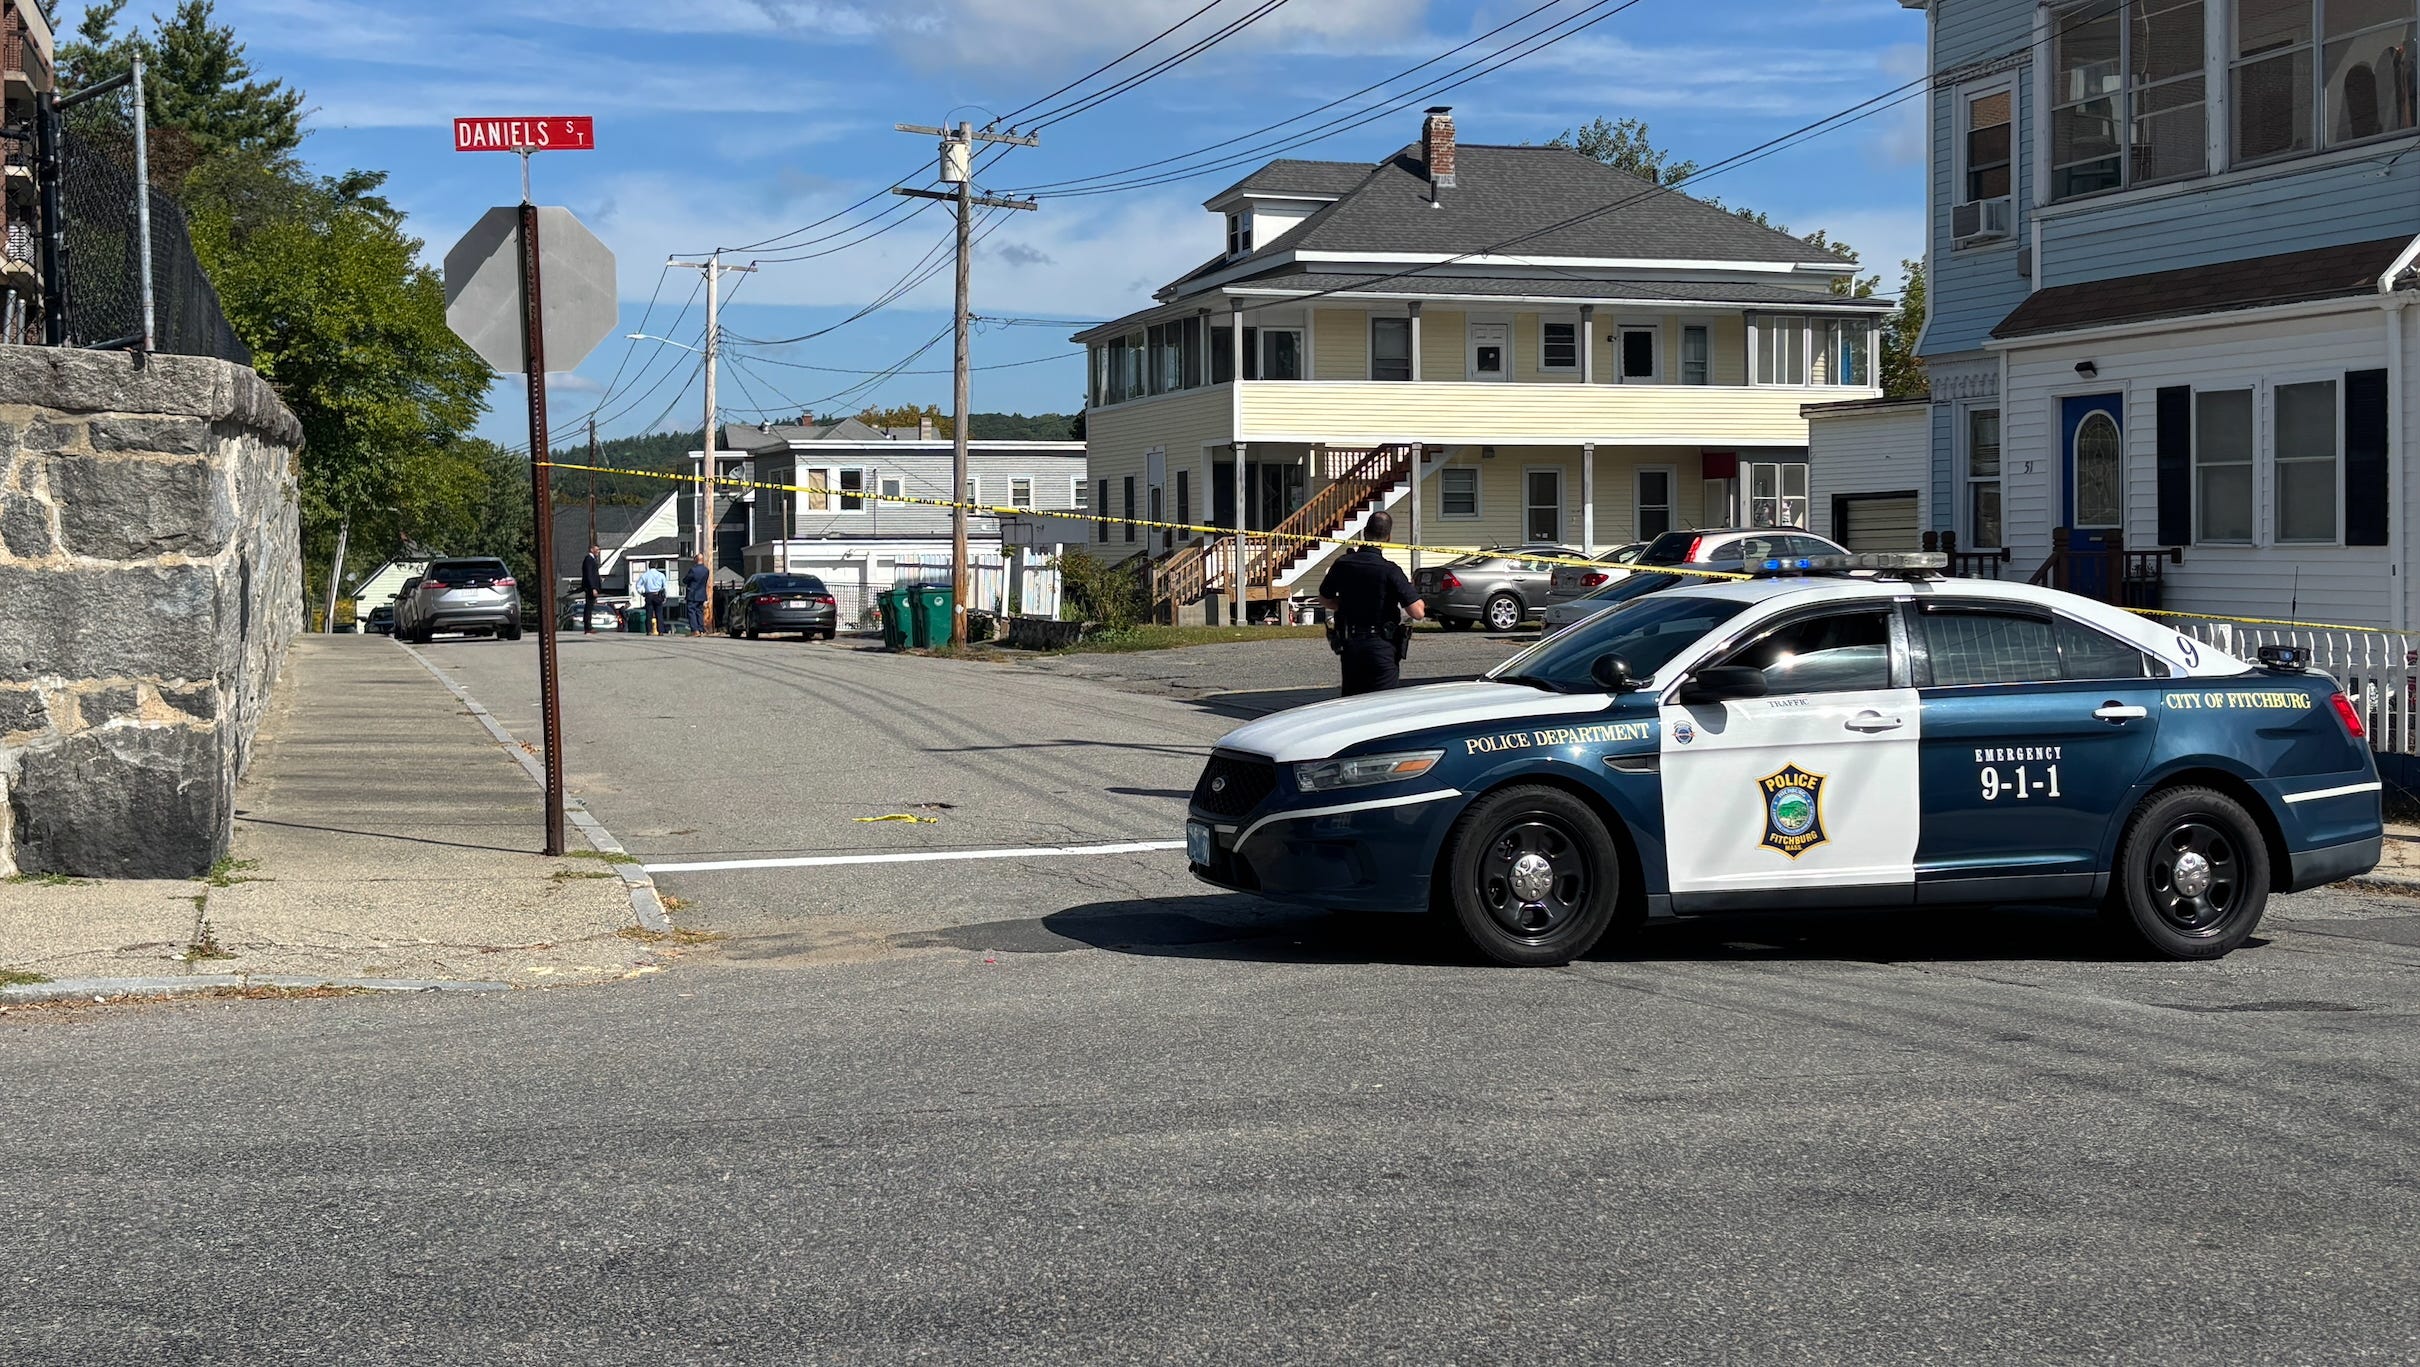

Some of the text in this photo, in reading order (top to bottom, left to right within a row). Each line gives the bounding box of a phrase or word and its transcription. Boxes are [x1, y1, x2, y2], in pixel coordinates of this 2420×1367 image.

[458, 120, 584, 147] DANIELS ST
[2176, 635, 2199, 668] 9
[1767, 698, 1810, 708] TRAFFIC
[2165, 692, 2311, 709] CITY OF FITCHBURG
[1465, 732, 1531, 755] POLICE
[1533, 722, 1650, 747] DEPARTMENT
[1974, 746, 2061, 762] EMERGENCY
[1765, 773, 1819, 792] POLICE
[1980, 764, 2060, 800] 9-1-1
[1769, 830, 1818, 845] FITCHBURG
